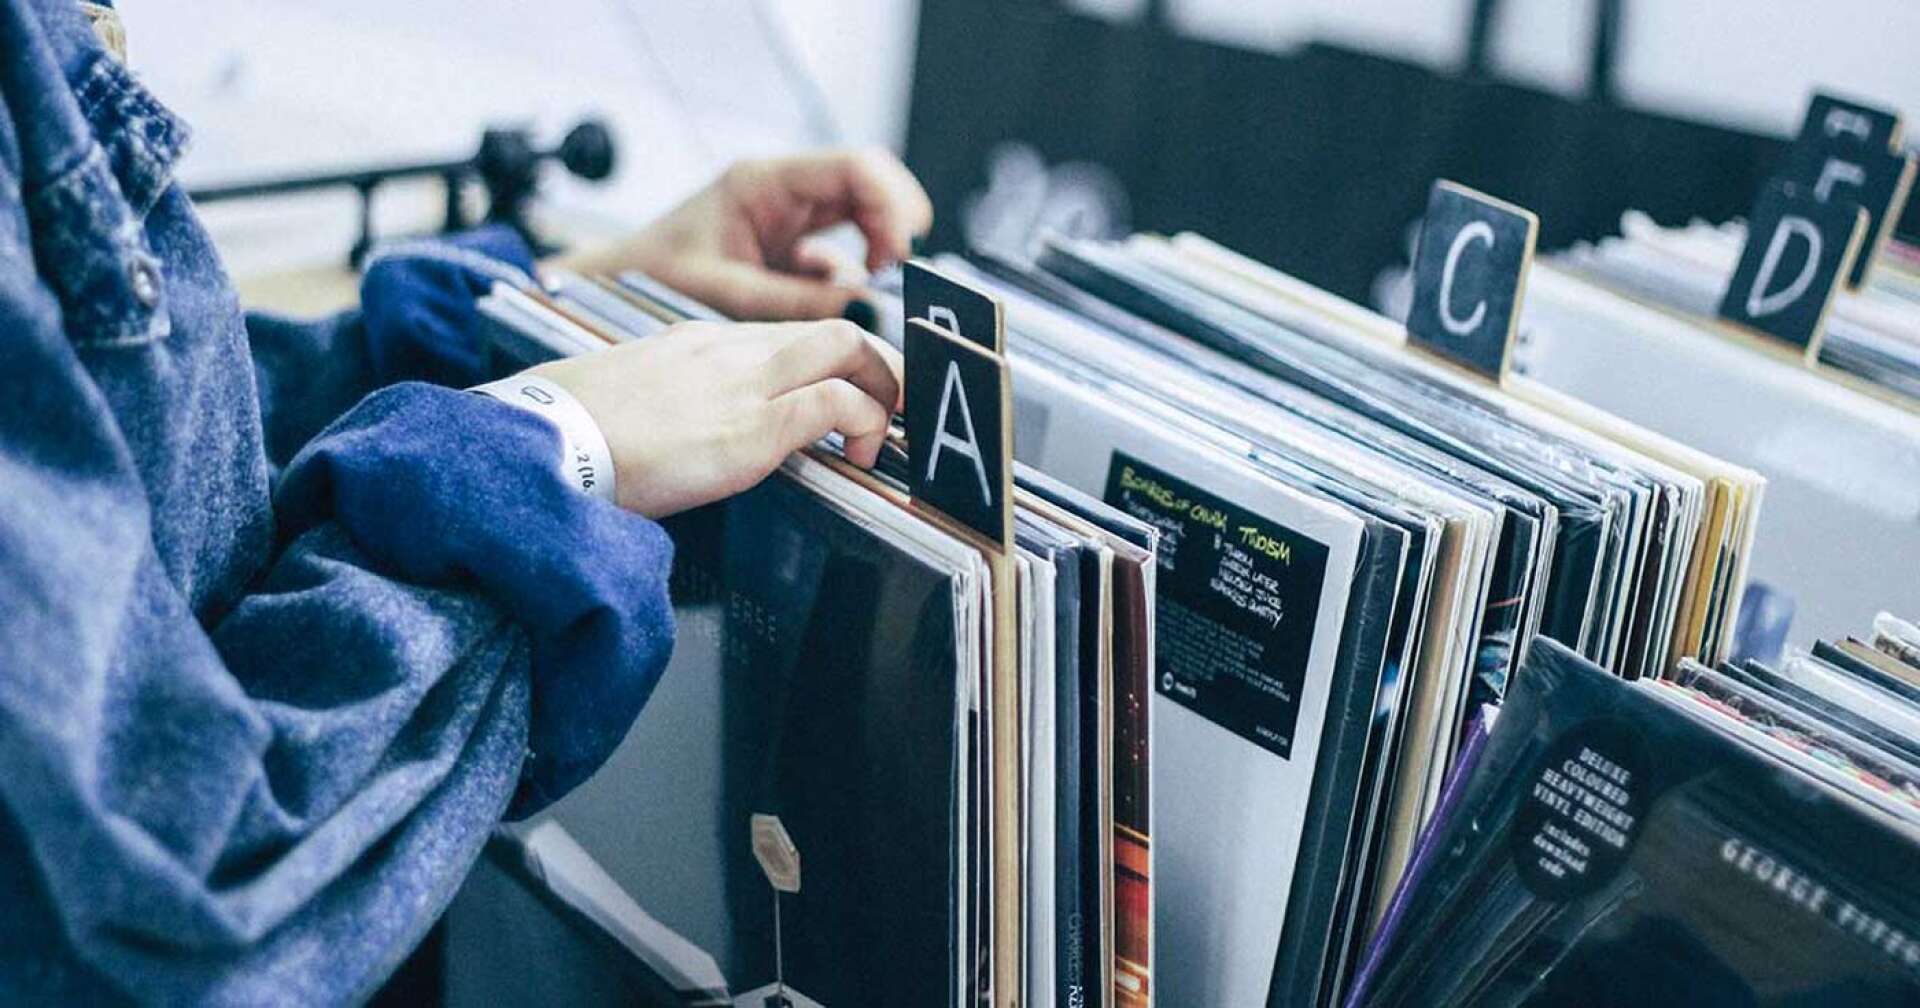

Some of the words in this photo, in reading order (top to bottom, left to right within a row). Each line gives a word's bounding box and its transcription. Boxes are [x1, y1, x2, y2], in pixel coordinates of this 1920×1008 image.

[1438, 220, 1495, 336] C
[1746, 214, 1822, 318] D
[925, 360, 991, 506] A
[1542, 768, 1635, 831] HEAVYWEIGHT
[1563, 759, 1630, 806] COLOURED
[1579, 747, 1631, 785] DELUXE
[1533, 782, 1572, 816] VINYL
[1574, 808, 1627, 848] EDITION
[1721, 837, 1828, 912] GEORGE
